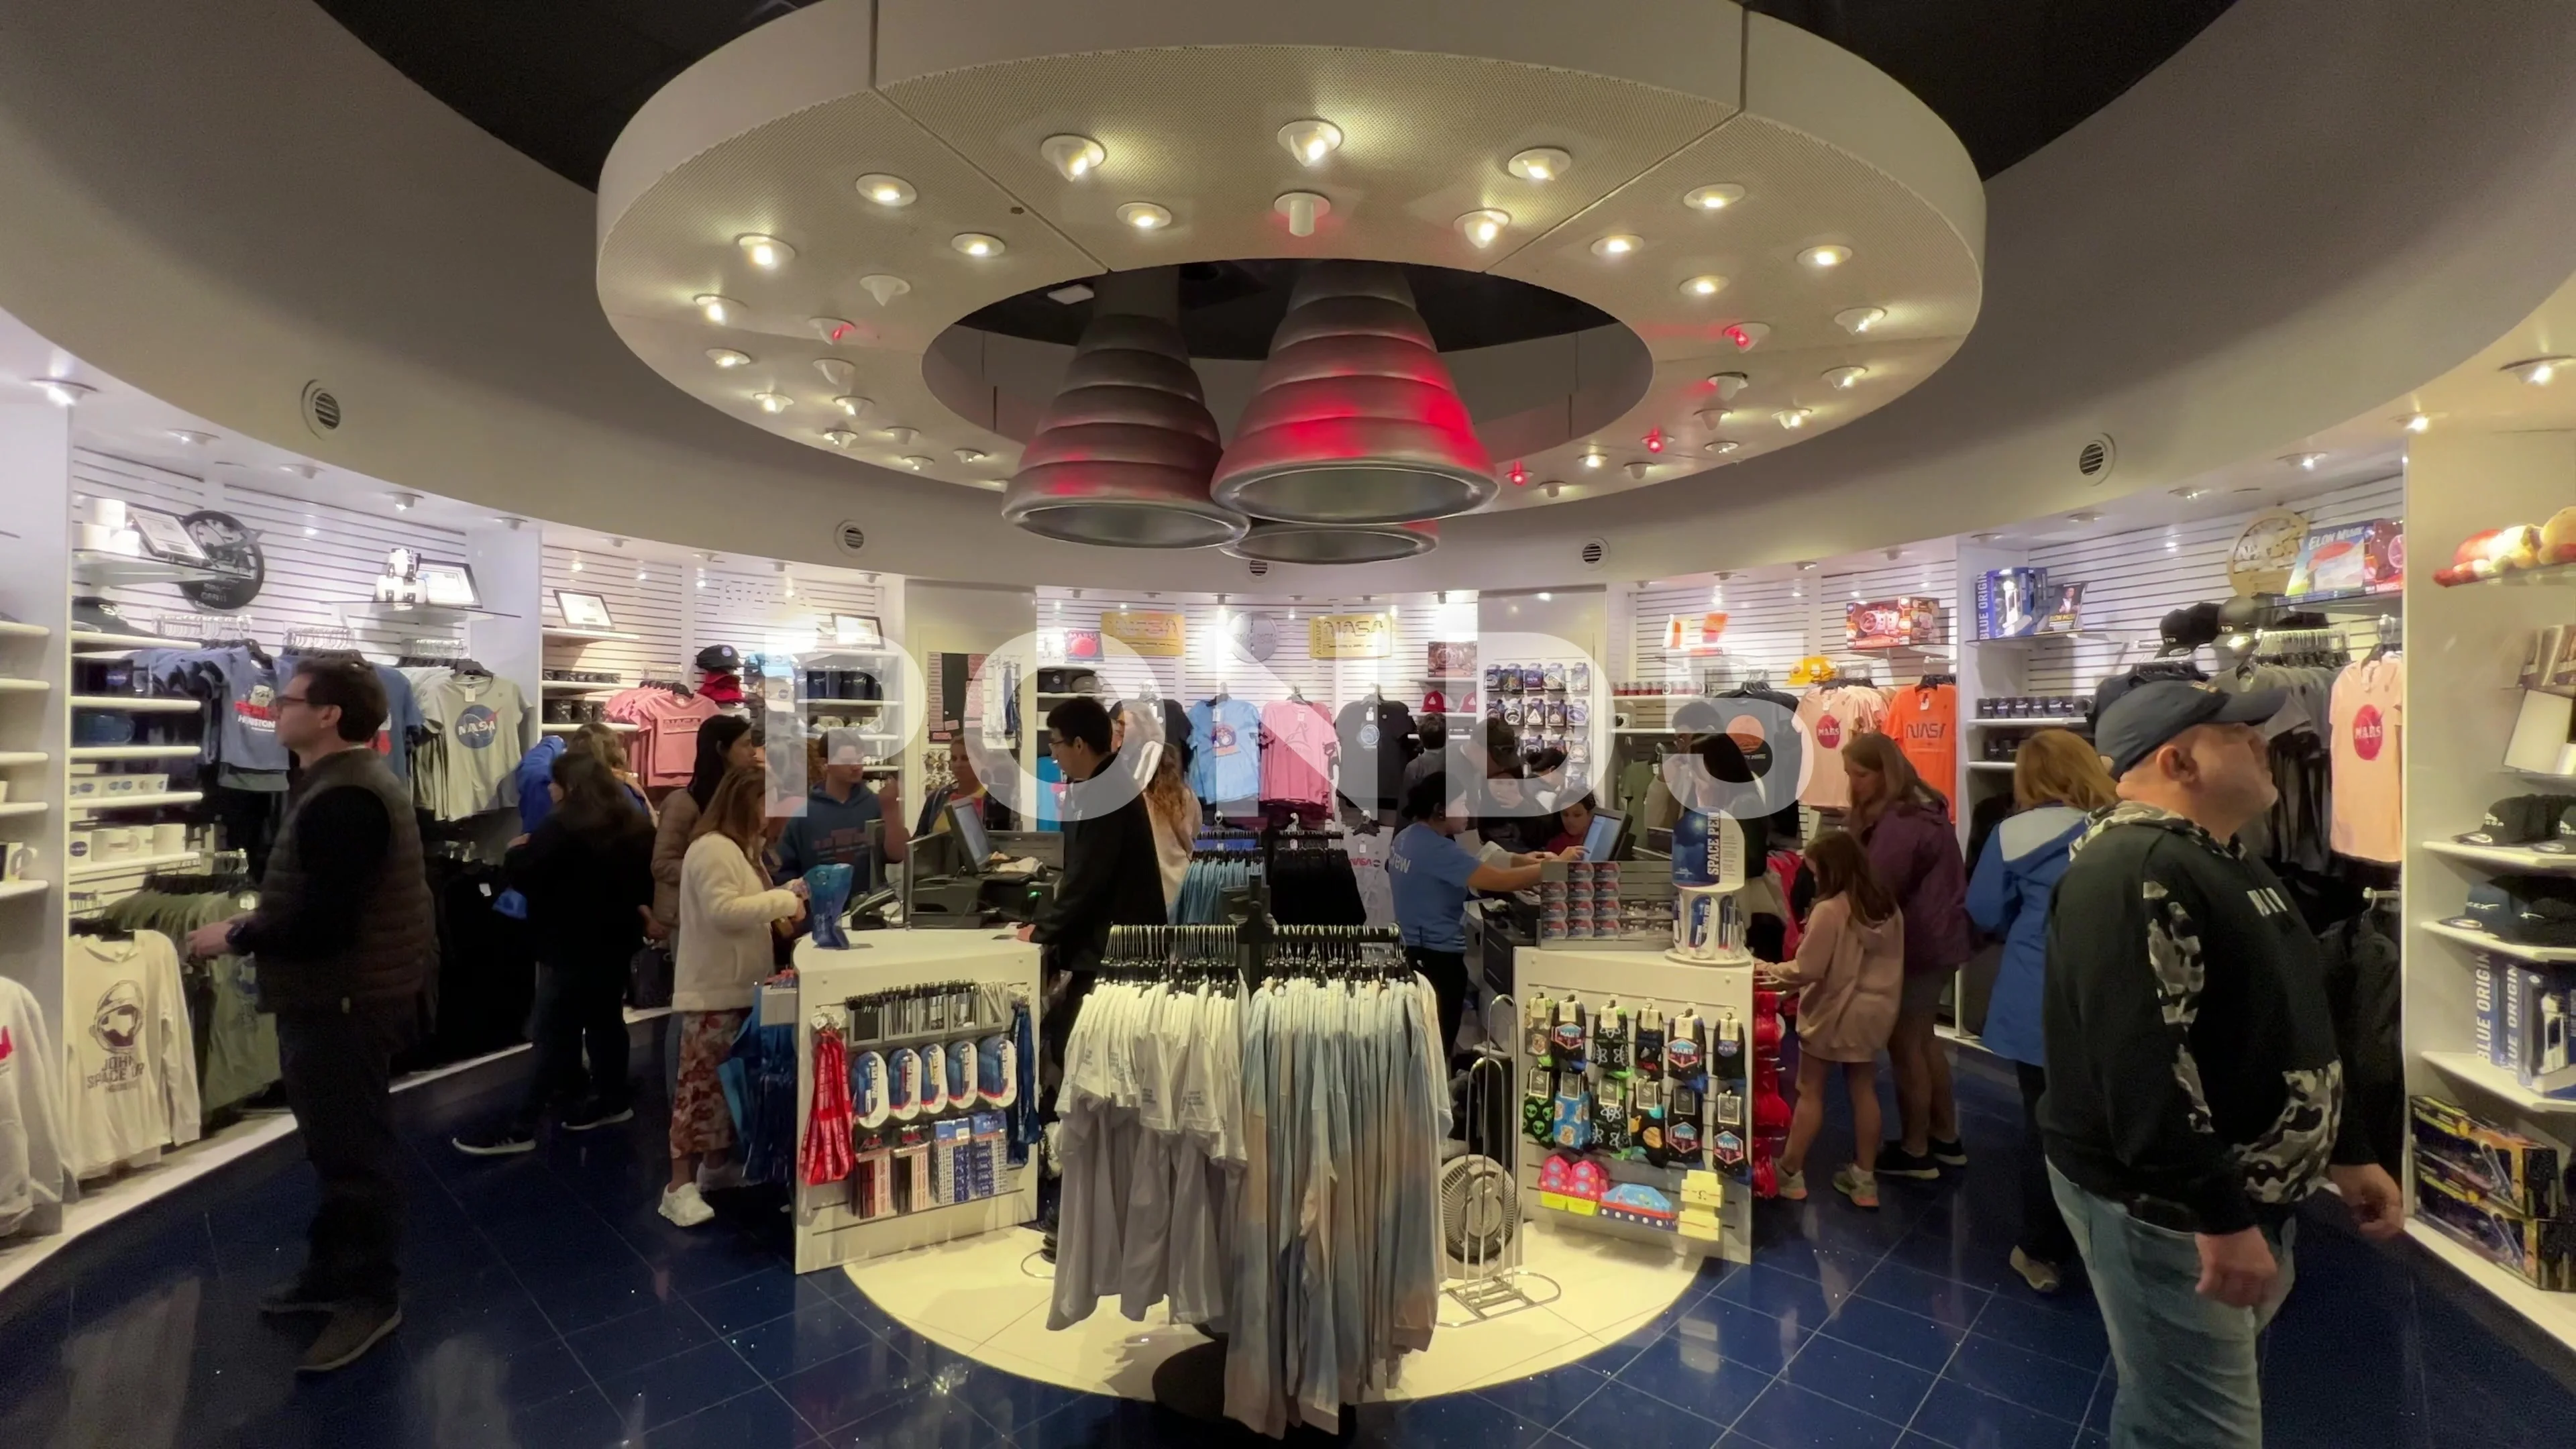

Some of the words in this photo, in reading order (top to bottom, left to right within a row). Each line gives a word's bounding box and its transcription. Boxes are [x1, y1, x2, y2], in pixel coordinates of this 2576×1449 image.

[2308, 532, 2336, 551] ELON
[1978, 611, 1990, 640] BLUE
[458, 720, 496, 735] NASA
[1818, 727, 1840, 736] MARS
[2355, 726, 2381, 739] MARS
[1707, 811, 1720, 839] PEN
[1707, 840, 1719, 875] SPACE
[1671, 1046, 1694, 1055] MARS
[87, 1068, 127, 1089] SPACE
